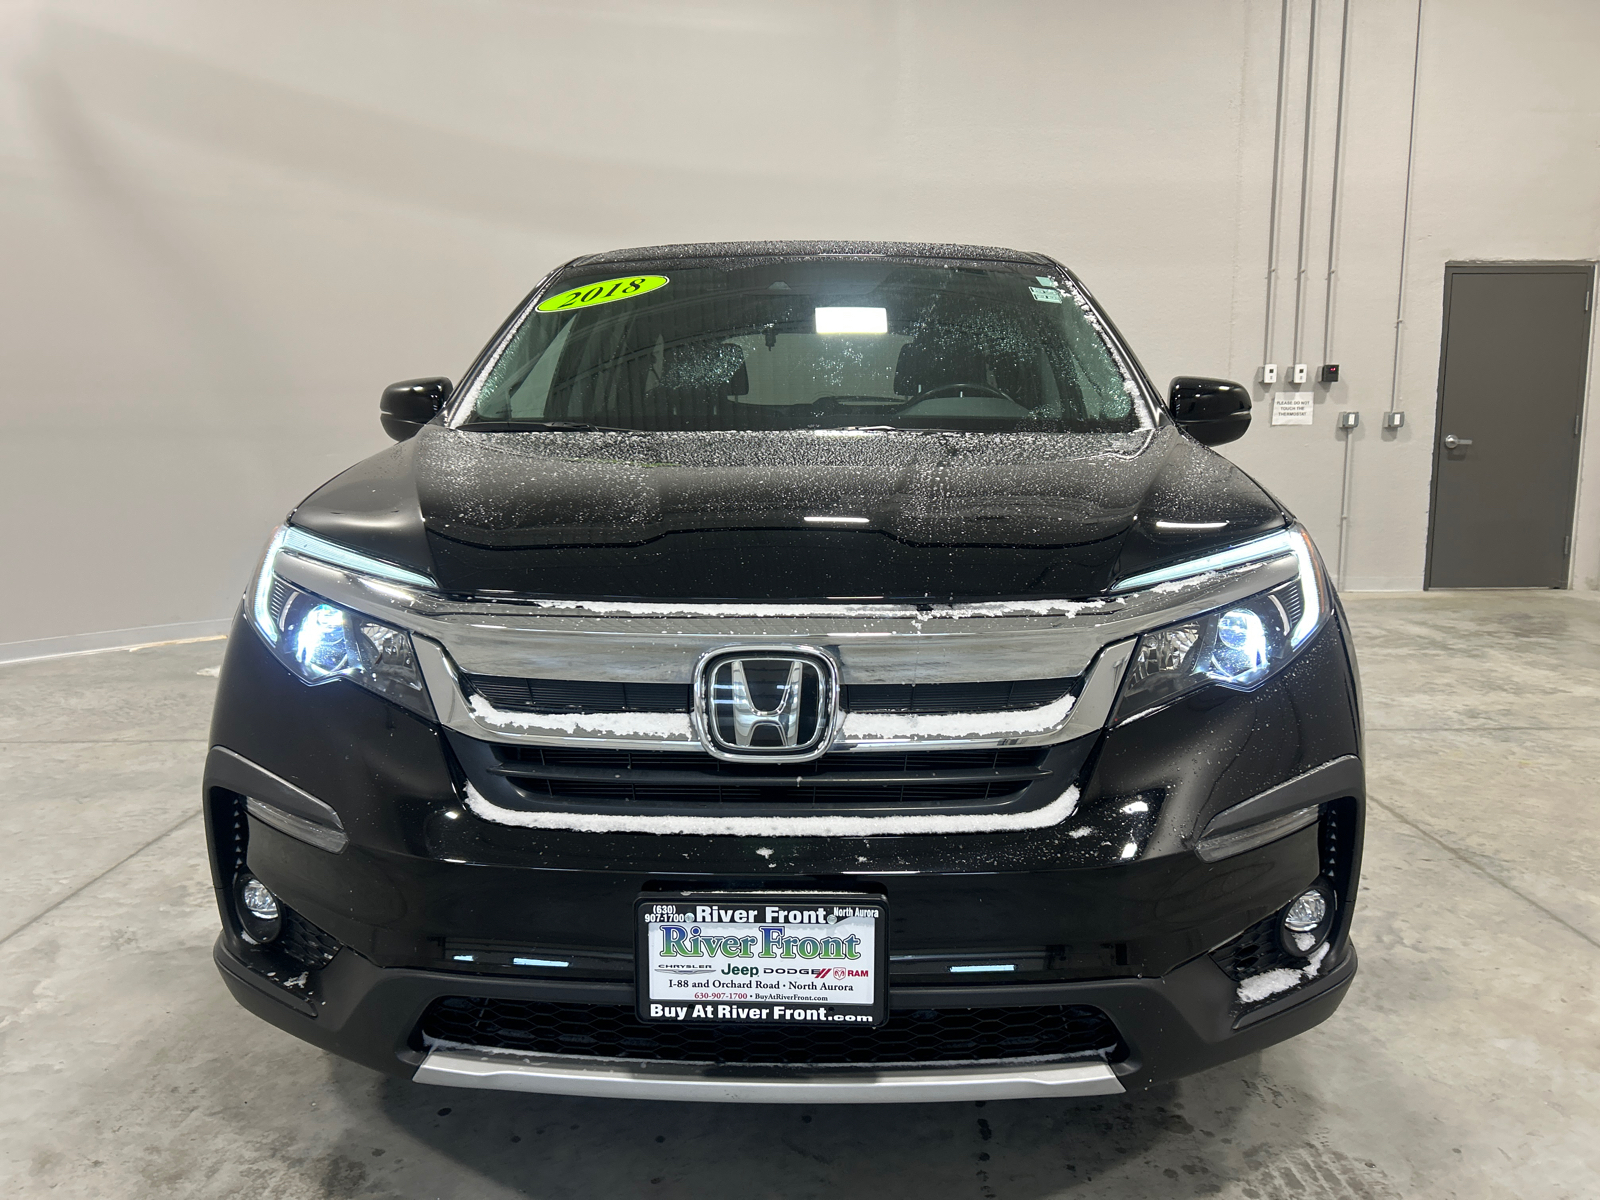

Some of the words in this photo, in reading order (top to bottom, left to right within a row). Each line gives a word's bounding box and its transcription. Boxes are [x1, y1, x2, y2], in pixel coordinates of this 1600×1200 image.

[557, 278, 646, 309] 2018
[652, 905, 676, 914] (630)
[696, 906, 758, 923] River
[765, 906, 826, 924] Front
[833, 906, 853, 917] North
[854, 907, 879, 918] Aurora
[644, 914, 685, 922] 907-1700
[659, 925, 758, 958] River
[758, 926, 861, 960] Front
[720, 963, 760, 978] Jeep
[668, 979, 689, 988] I-88
[692, 979, 710, 988] and
[712, 980, 752, 989] Orchard
[755, 980, 780, 990] Road
[788, 981, 818, 990] North
[820, 982, 854, 992] Aurora
[694, 992, 748, 1000] 630-907-1700
[754, 993, 828, 1002] BuyAtRiverFront.com
[650, 1004, 688, 1020] Buy
[692, 1004, 714, 1018] At
[718, 1004, 770, 1019] River
